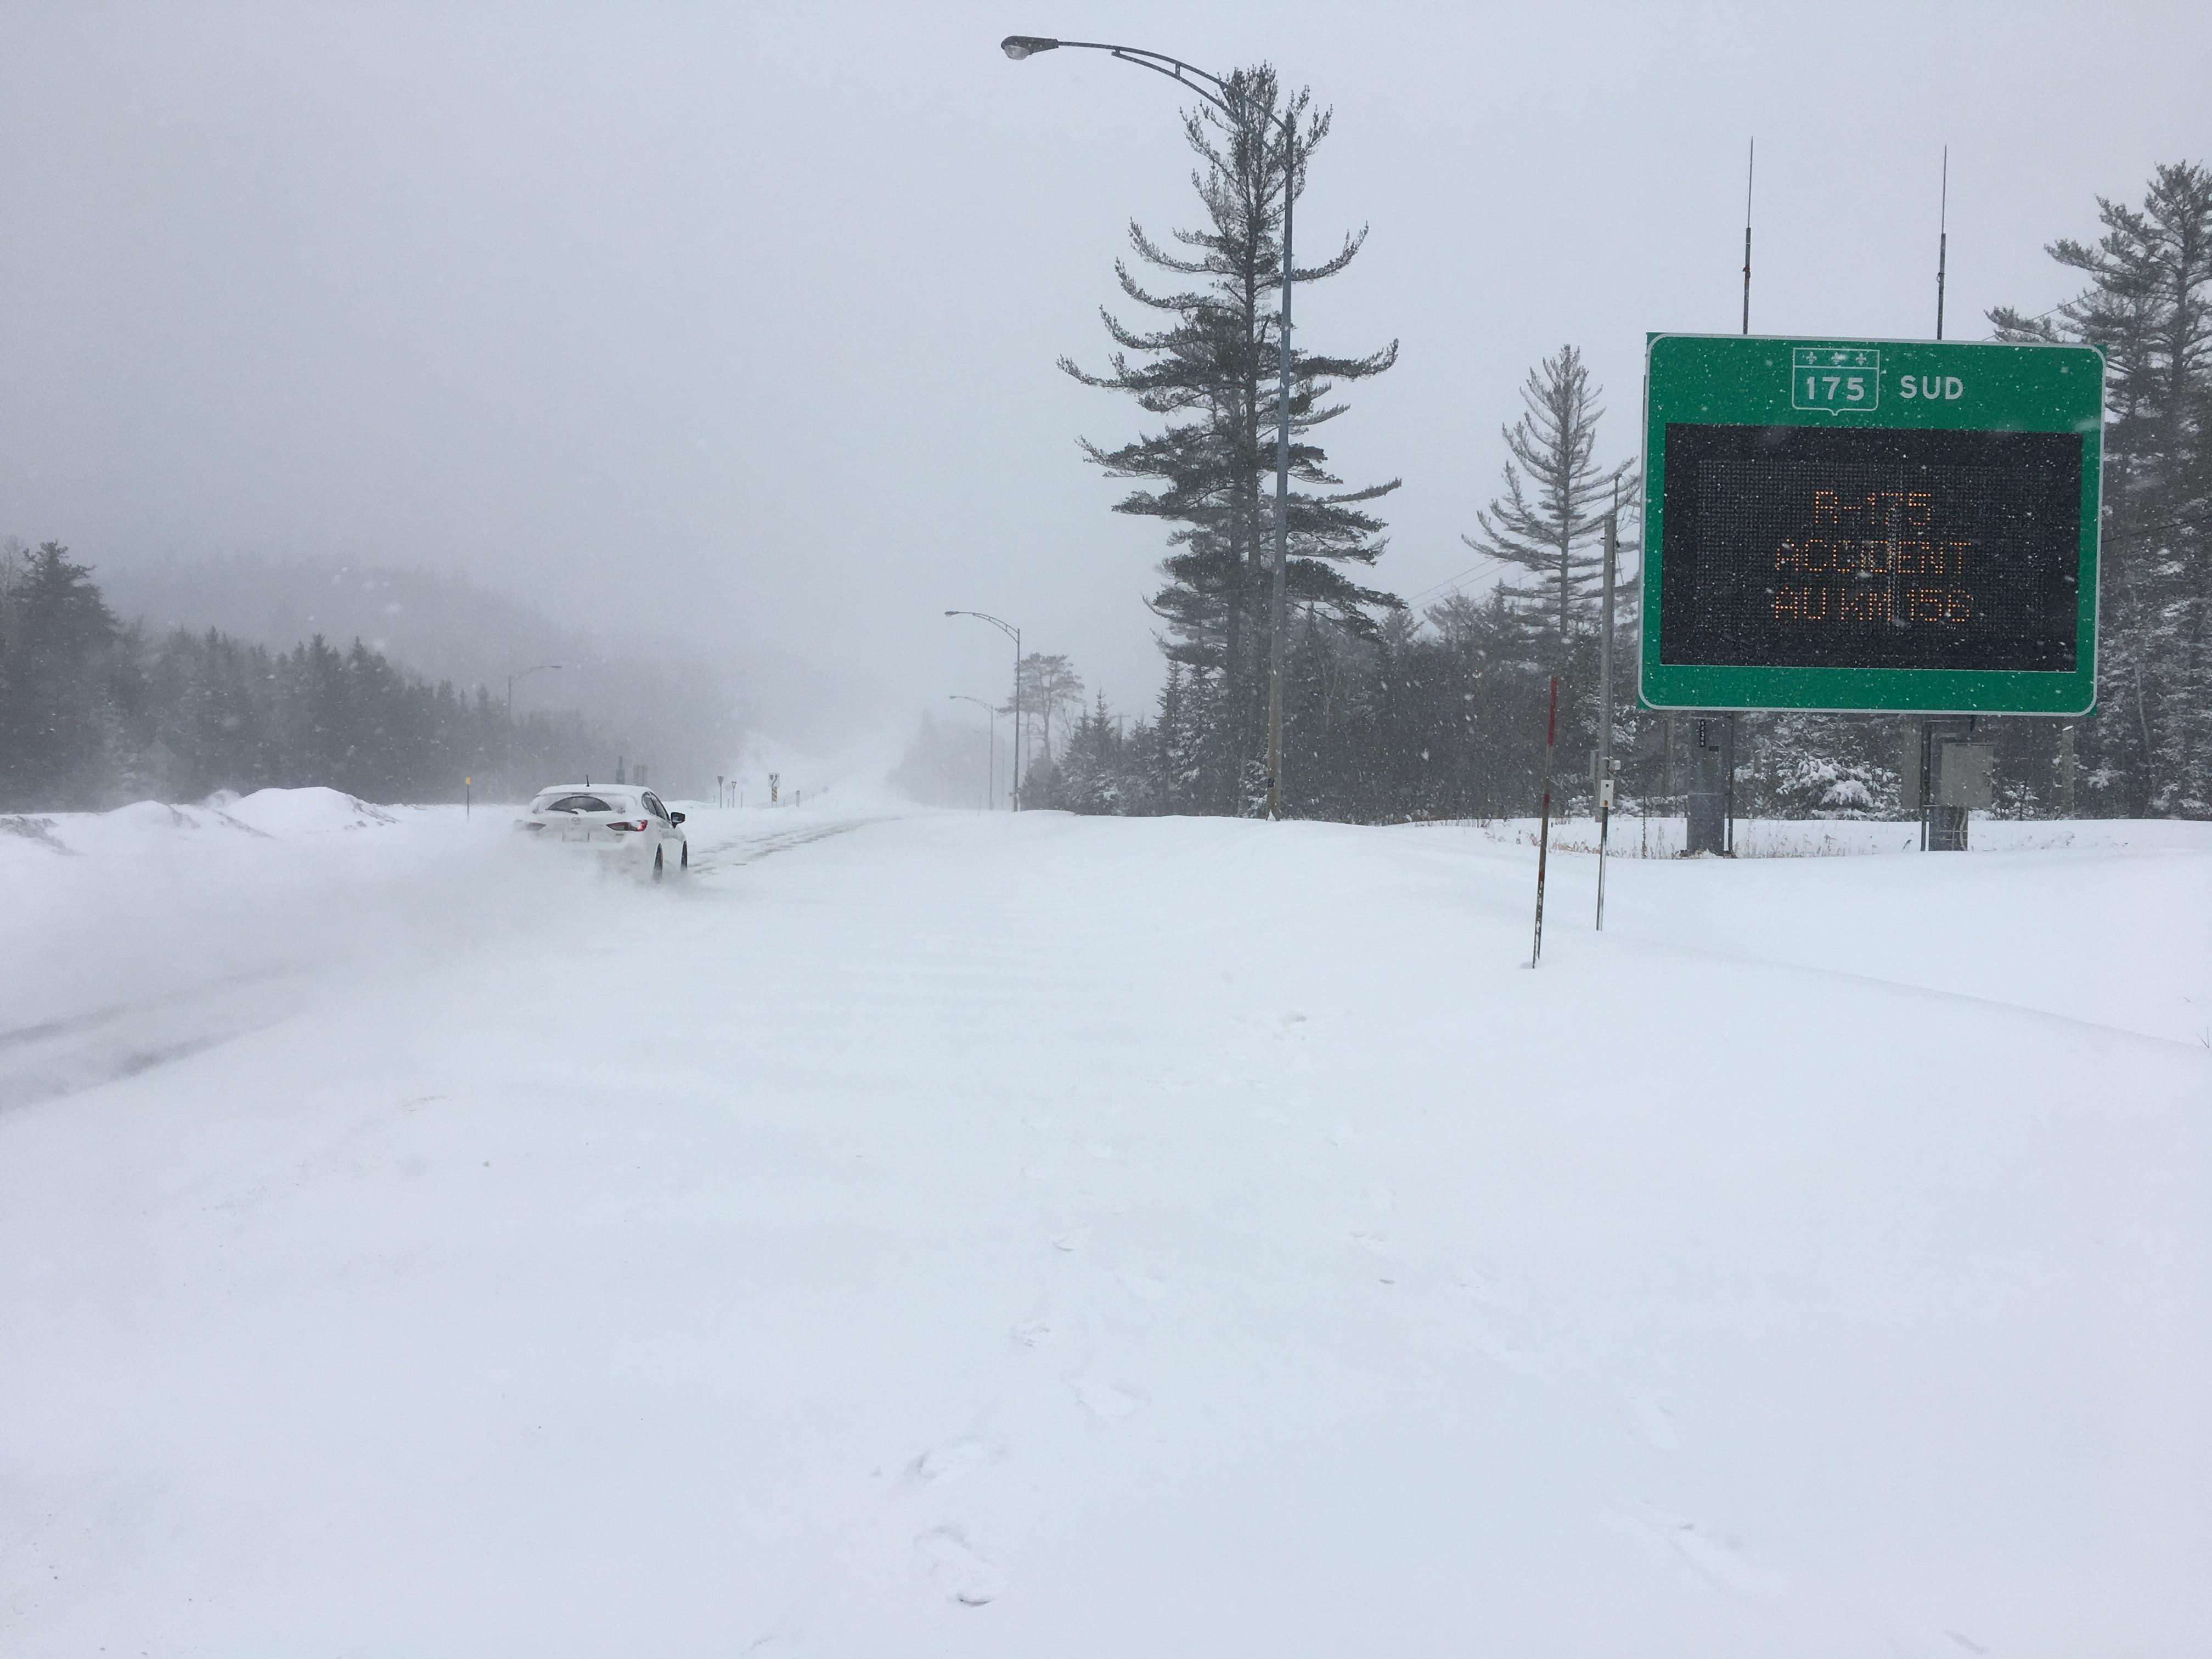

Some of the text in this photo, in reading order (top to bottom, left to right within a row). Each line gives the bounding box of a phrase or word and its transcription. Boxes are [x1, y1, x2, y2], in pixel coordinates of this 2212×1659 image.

[1807, 375, 1963, 401] 175 SUD
[1815, 490, 1931, 526] R-175
[1776, 538, 1972, 574] ACCIDENT
[1775, 586, 1971, 623] AU KM 156
